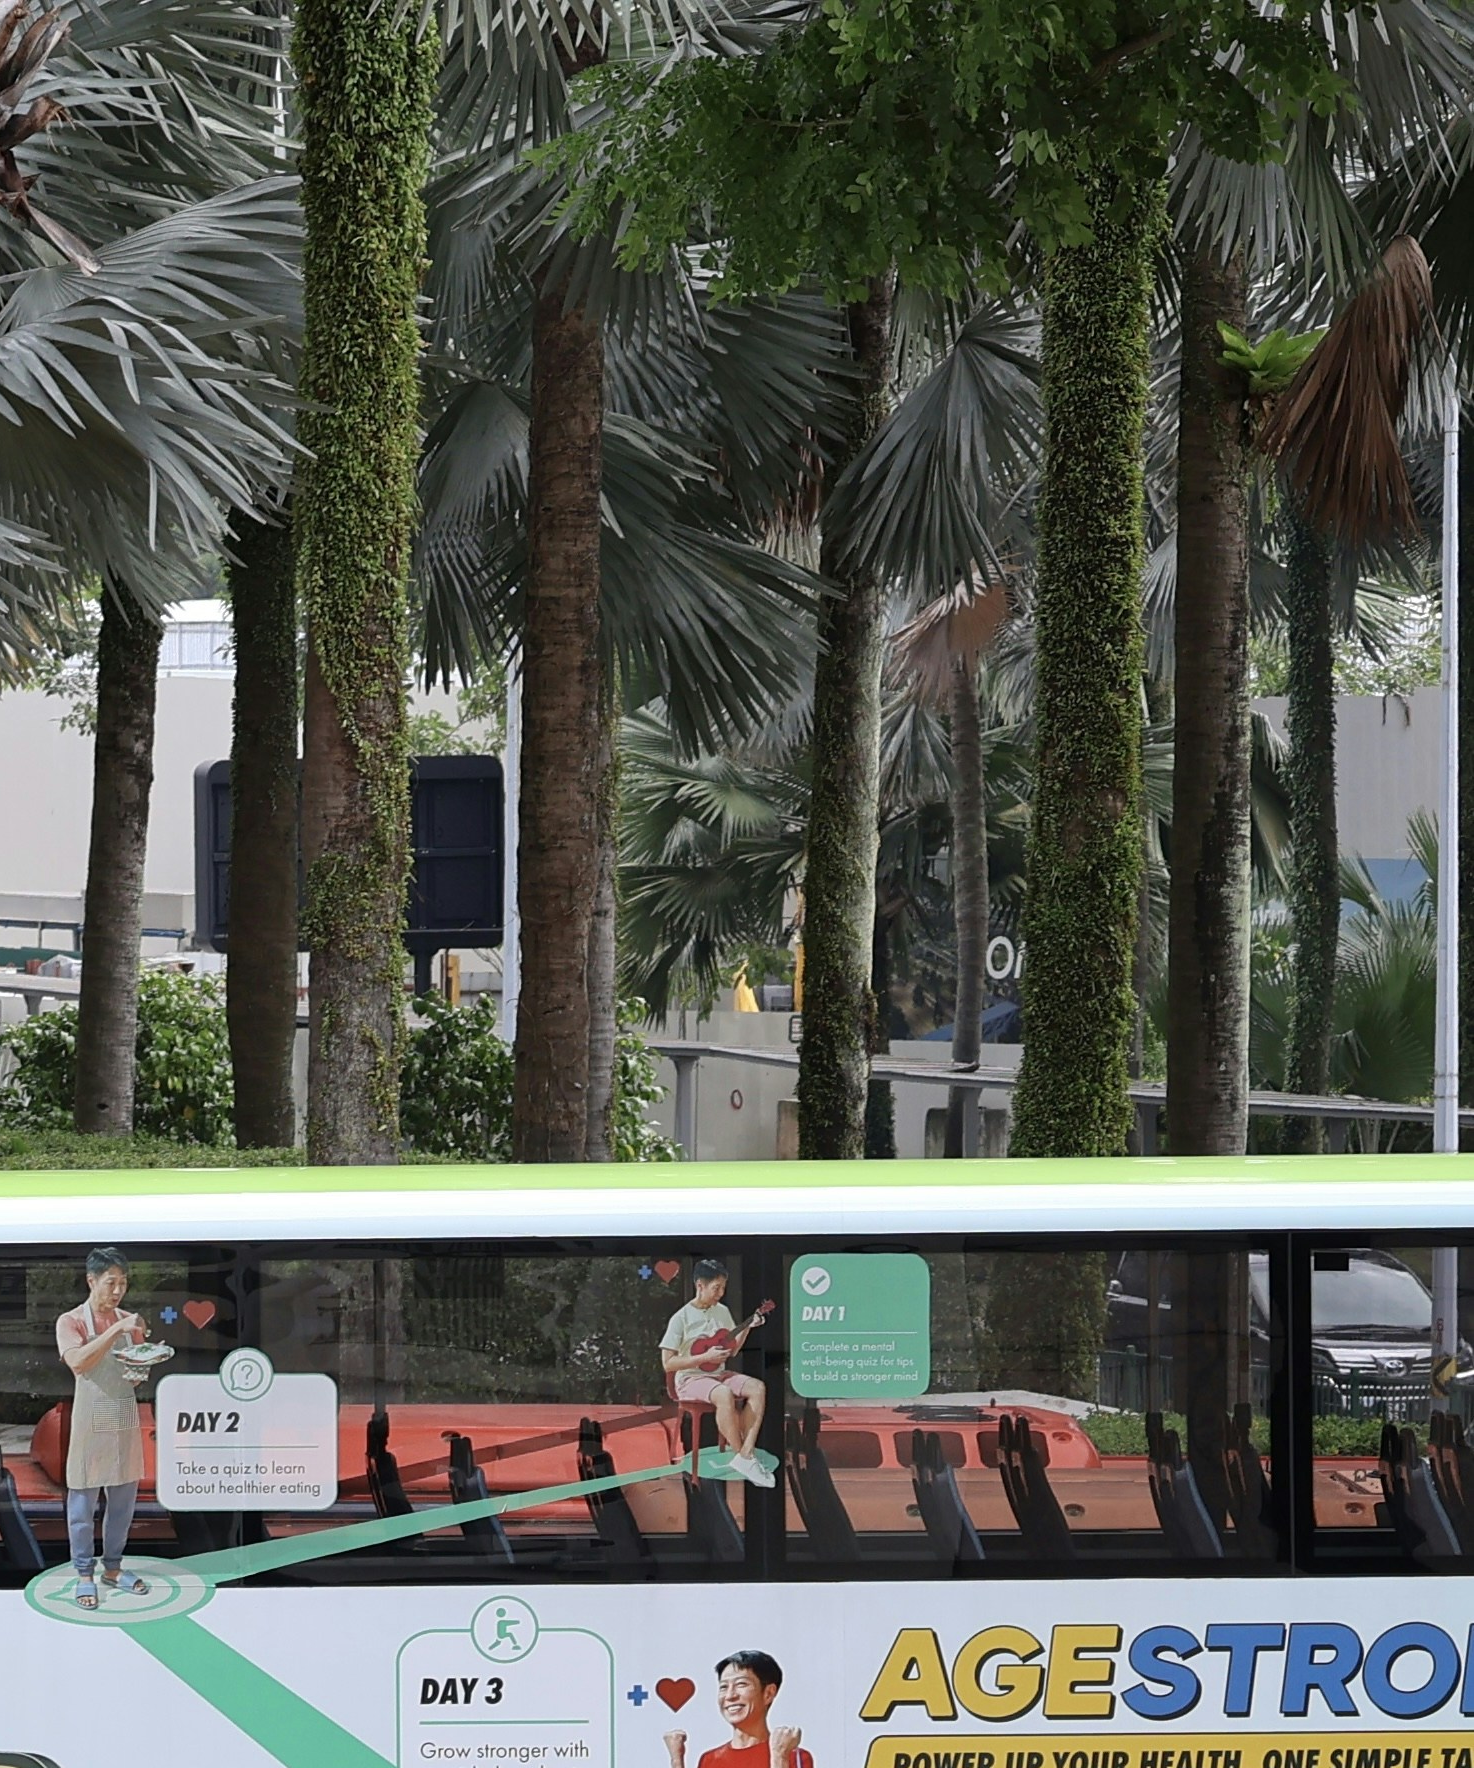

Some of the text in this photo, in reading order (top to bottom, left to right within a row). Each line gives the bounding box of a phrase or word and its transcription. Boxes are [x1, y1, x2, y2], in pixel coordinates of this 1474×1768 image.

[801, 1306, 846, 1321] DAY 1
[801, 1341, 895, 1353] Complete a mental
[801, 1355, 914, 1369] well-being quiz for tips
[801, 1372, 811, 1381] to
[813, 1371, 839, 1381] build
[850, 1372, 892, 1384] stronger
[893, 1370, 919, 1381] mind
[176, 1411, 240, 1433] DAY 2
[176, 1461, 306, 1478] Take a quiz to learn
[176, 1480, 321, 1497] about healthier eating
[859, 1621, 1474, 1723] AGESTRO
[420, 1676, 504, 1705] DAY 3
[420, 1739, 590, 1763] Grow stronger with
